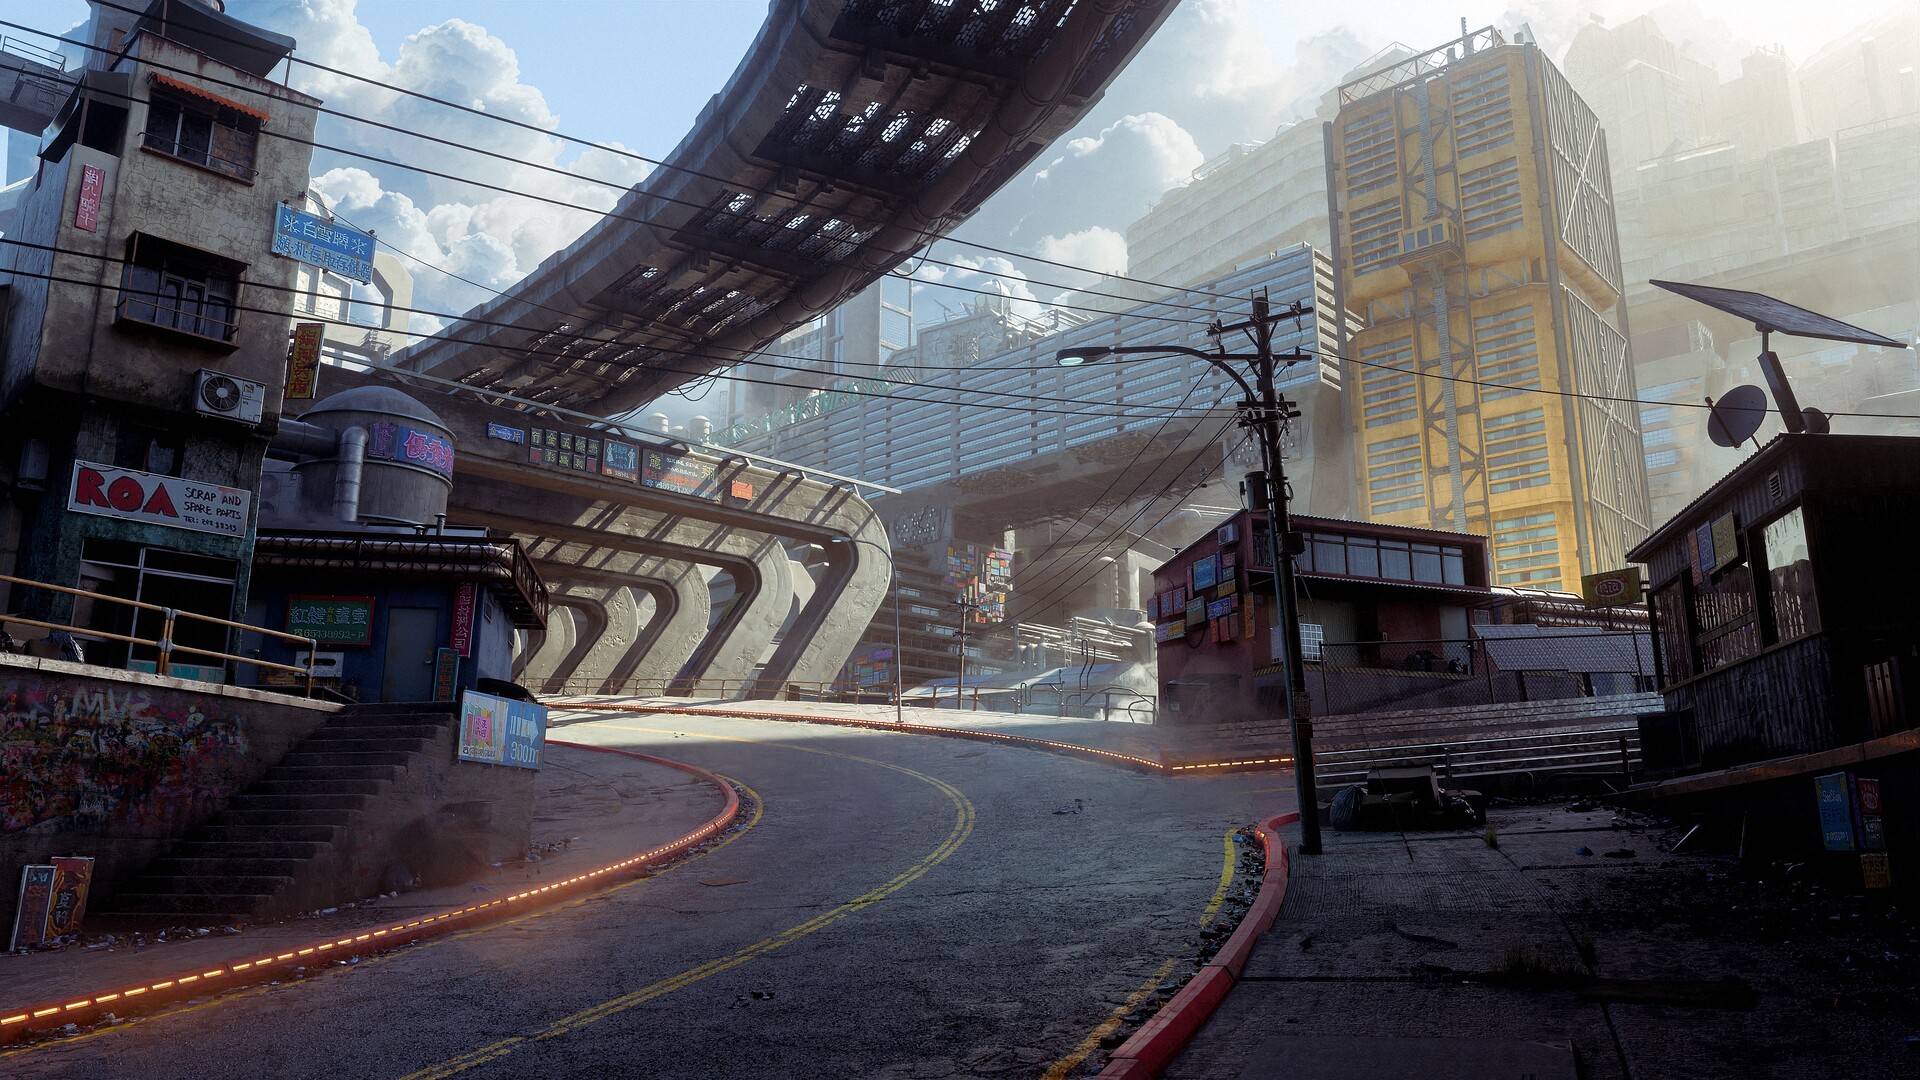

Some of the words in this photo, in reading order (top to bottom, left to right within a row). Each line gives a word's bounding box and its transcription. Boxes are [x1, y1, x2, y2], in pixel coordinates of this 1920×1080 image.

[75, 468, 179, 518] ROA
[185, 487, 216, 502] SCRAP
[221, 495, 242, 506] AND
[183, 501, 213, 516] SPARE
[216, 508, 242, 520] PARTS
